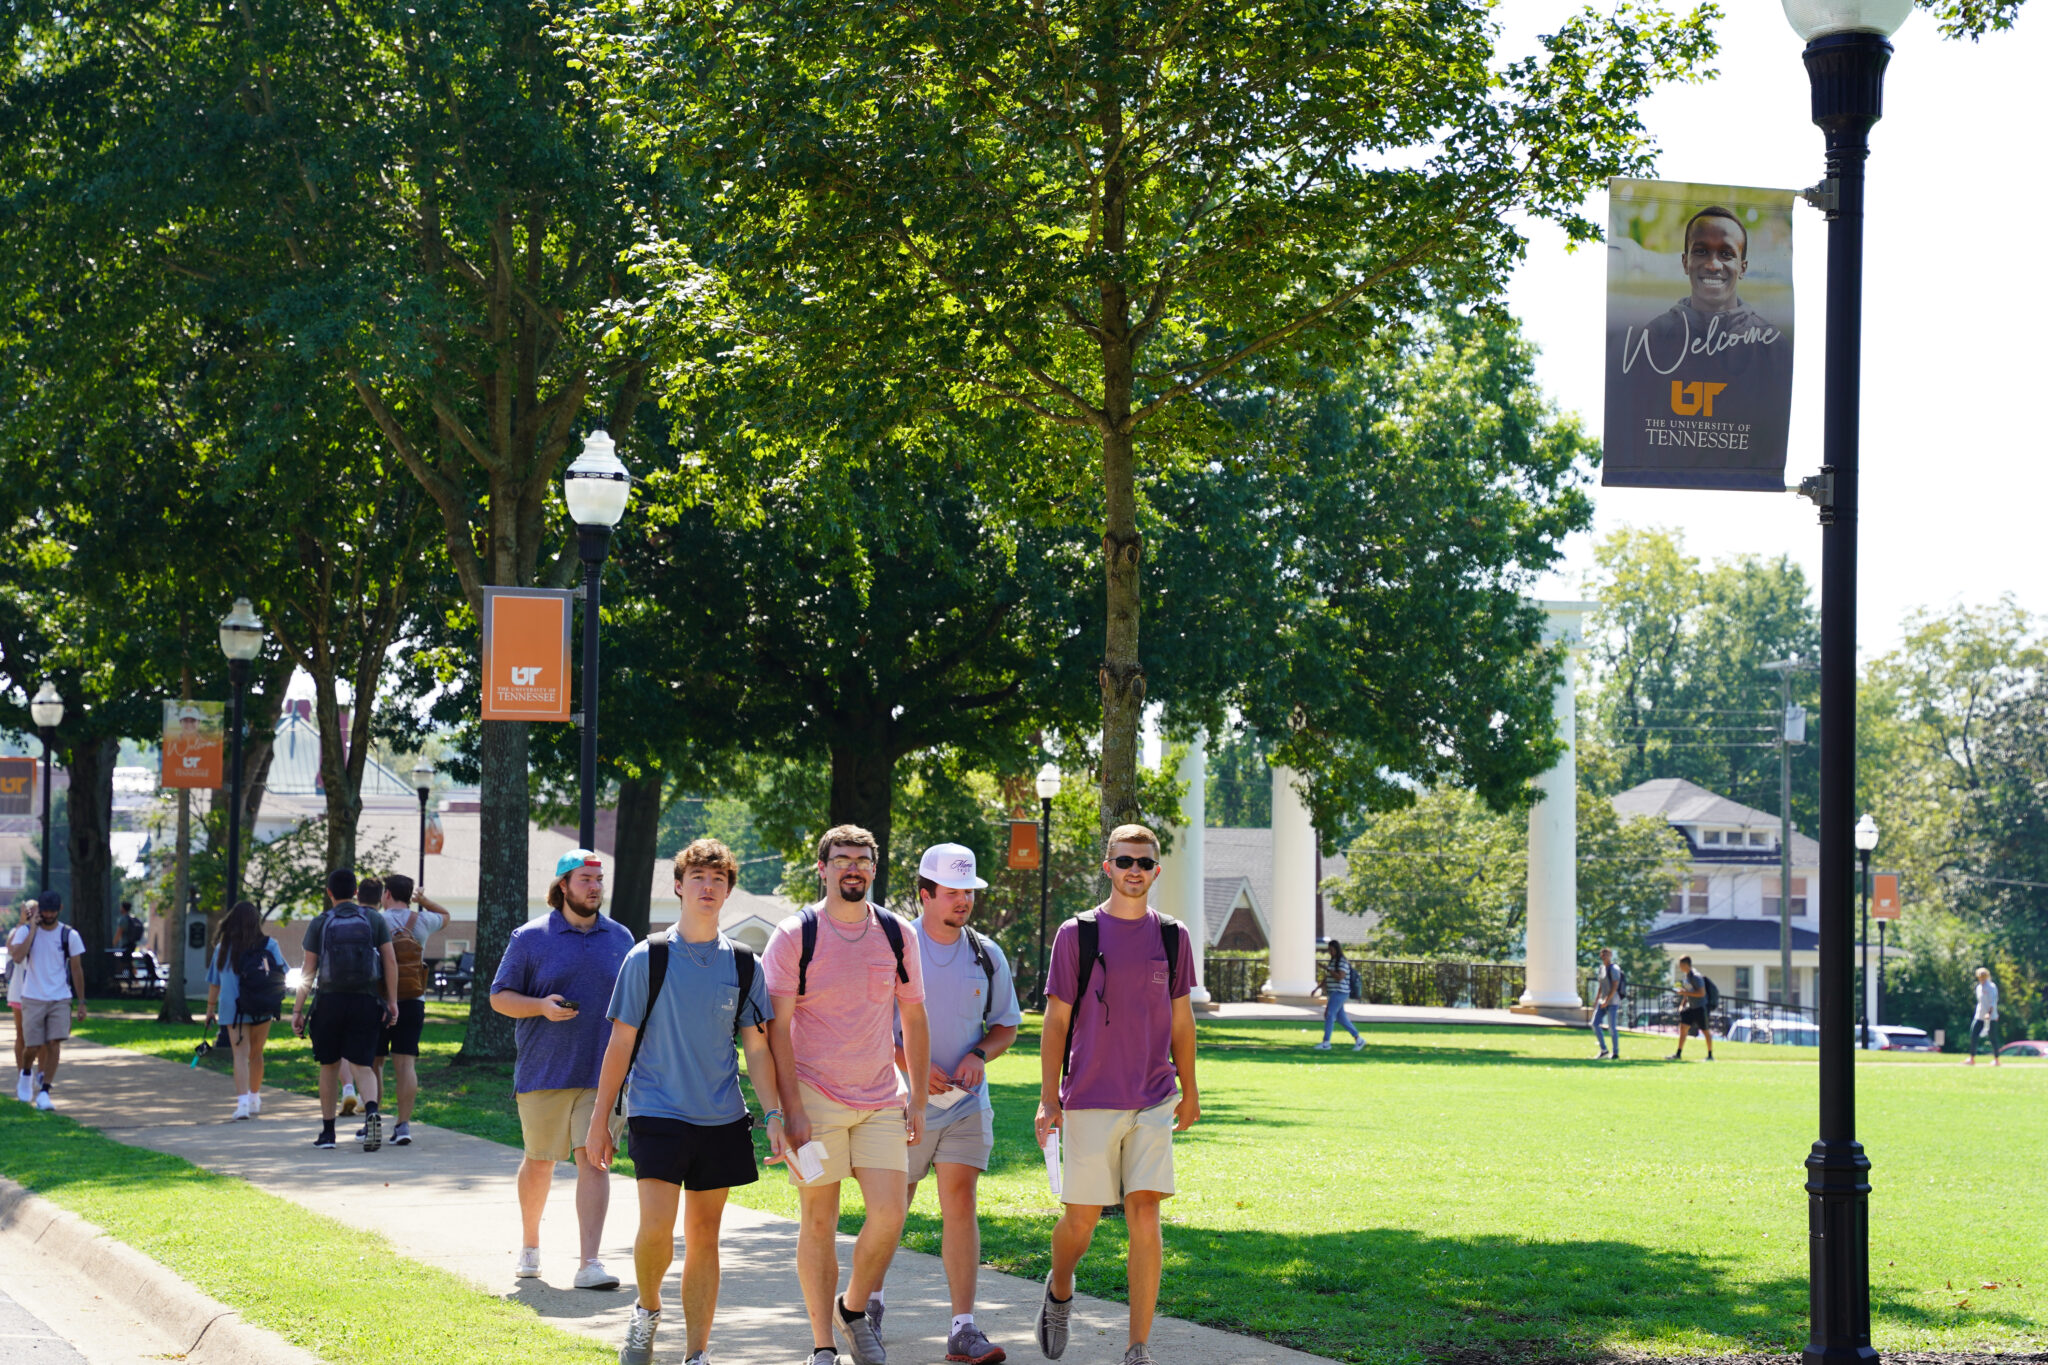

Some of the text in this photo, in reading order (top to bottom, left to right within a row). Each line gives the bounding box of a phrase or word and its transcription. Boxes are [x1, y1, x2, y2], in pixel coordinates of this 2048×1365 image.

[1622, 311, 1781, 375] Welcome
[1645, 418, 1751, 432] THE UNIVERSITY OF
[1645, 428, 1749, 450] TENNESSEE
[496, 691, 556, 702] TENNESSEE
